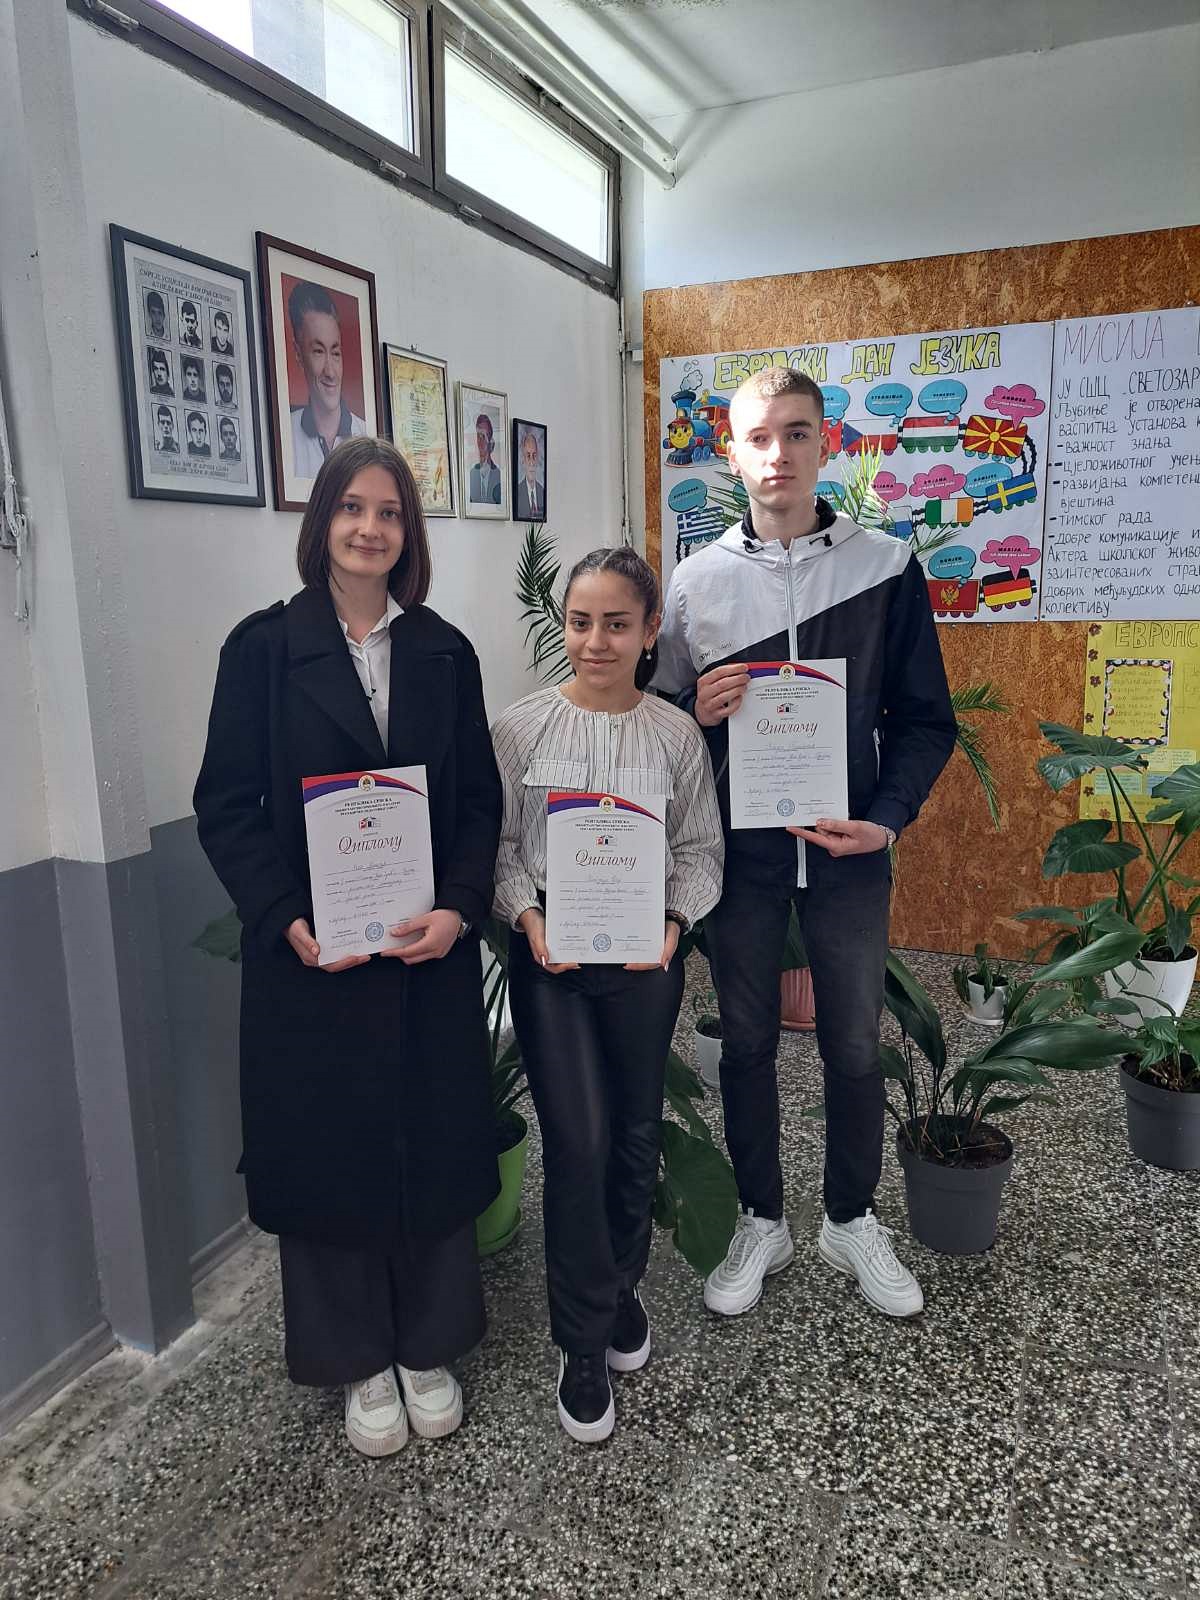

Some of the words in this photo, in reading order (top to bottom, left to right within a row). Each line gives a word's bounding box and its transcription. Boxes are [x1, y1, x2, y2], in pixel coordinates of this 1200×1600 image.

[1063, 316, 1164, 365] МИСИЈА
[841, 343, 895, 384] ДАН
[910, 332, 1001, 375] ЈЕЗИКА
[1055, 402, 1108, 422] Љубиње
[1125, 399, 1138, 420] је
[1147, 397, 1200, 413] отворена
[1059, 420, 1117, 436] васпитна
[1128, 416, 1187, 436] установа
[1131, 437, 1172, 450] знања
[1061, 496, 1115, 513] вјештина
[1118, 511, 1152, 527] рада
[1100, 528, 1180, 546] комуникације
[1047, 545, 1088, 561] Актера
[1099, 547, 1157, 561] школског
[1048, 566, 1152, 580] заинтересованих
[1168, 564, 1200, 580] стра
[1044, 585, 1085, 599] добрих
